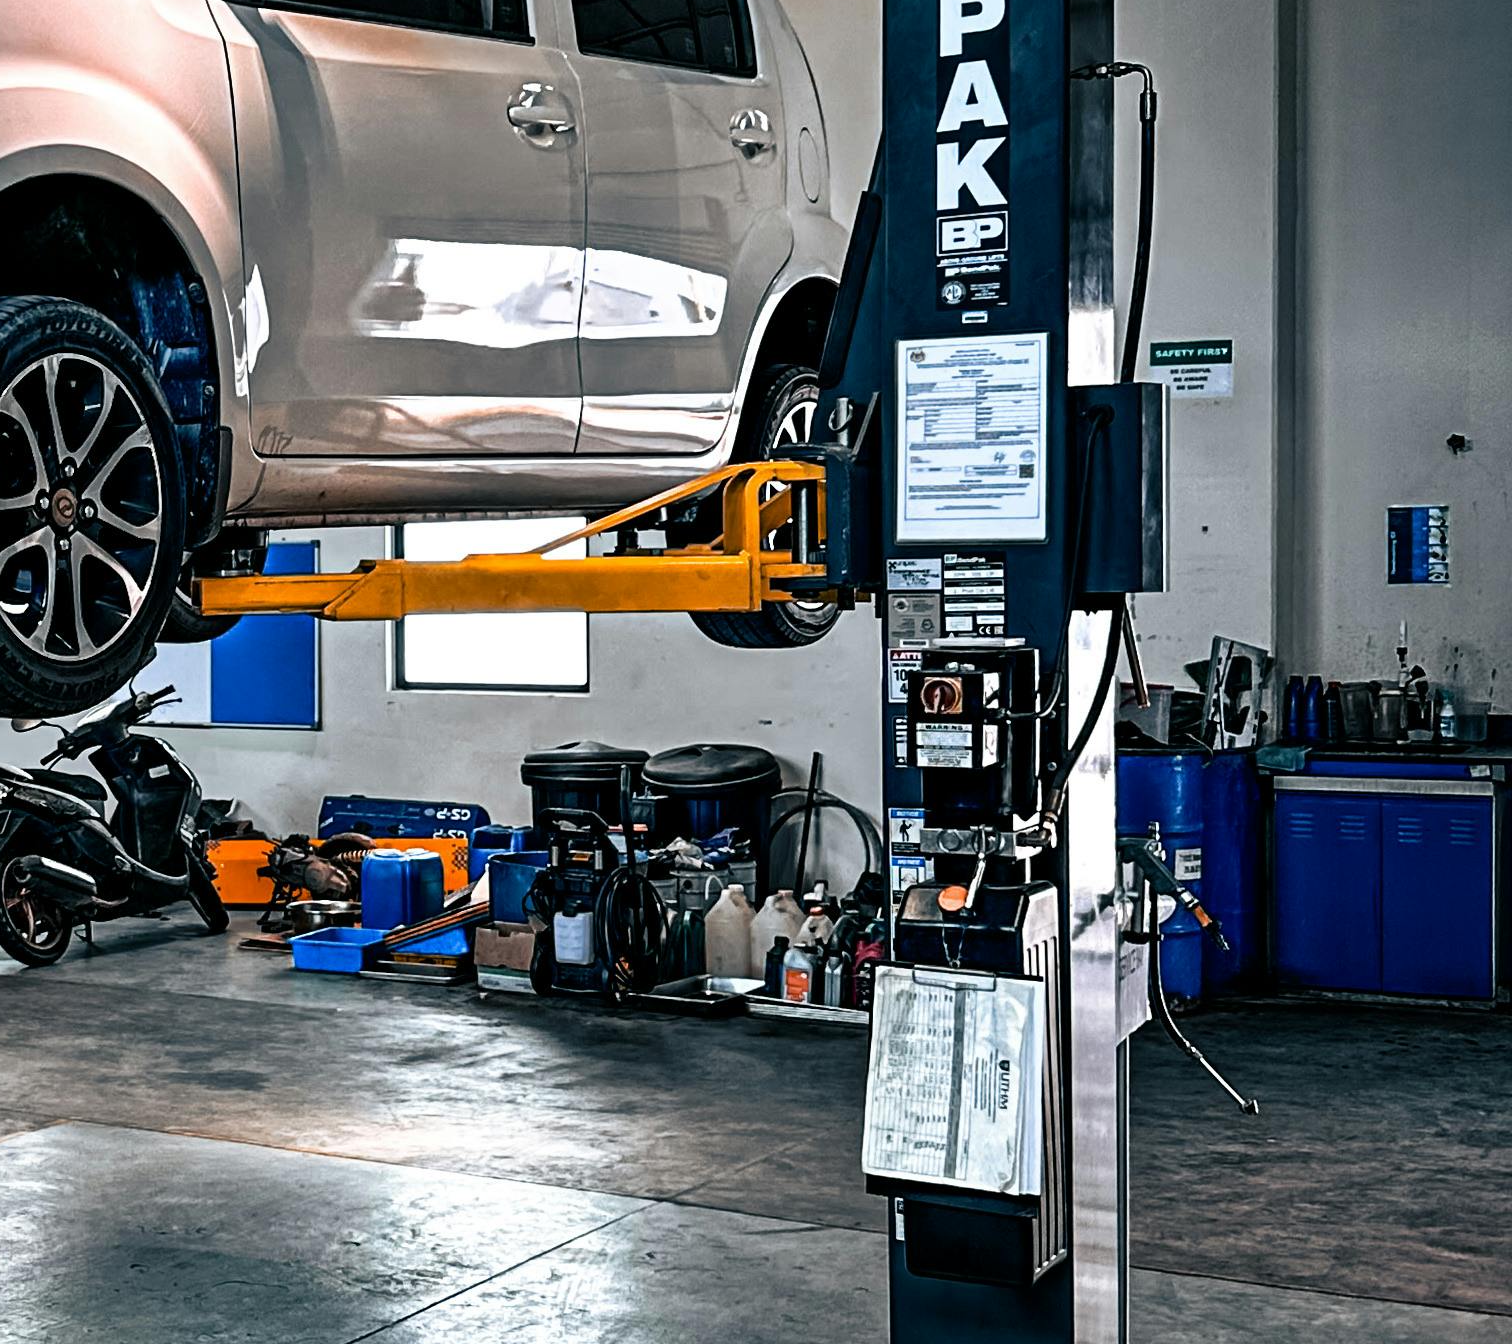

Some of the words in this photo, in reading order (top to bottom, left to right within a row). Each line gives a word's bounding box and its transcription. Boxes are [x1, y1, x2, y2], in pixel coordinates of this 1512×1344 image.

[942, 217, 1004, 251] BP
[1155, 349, 1194, 358] SAFETY
[1197, 347, 1228, 356] FIRST
[999, 1072, 1010, 1110] UTHM
